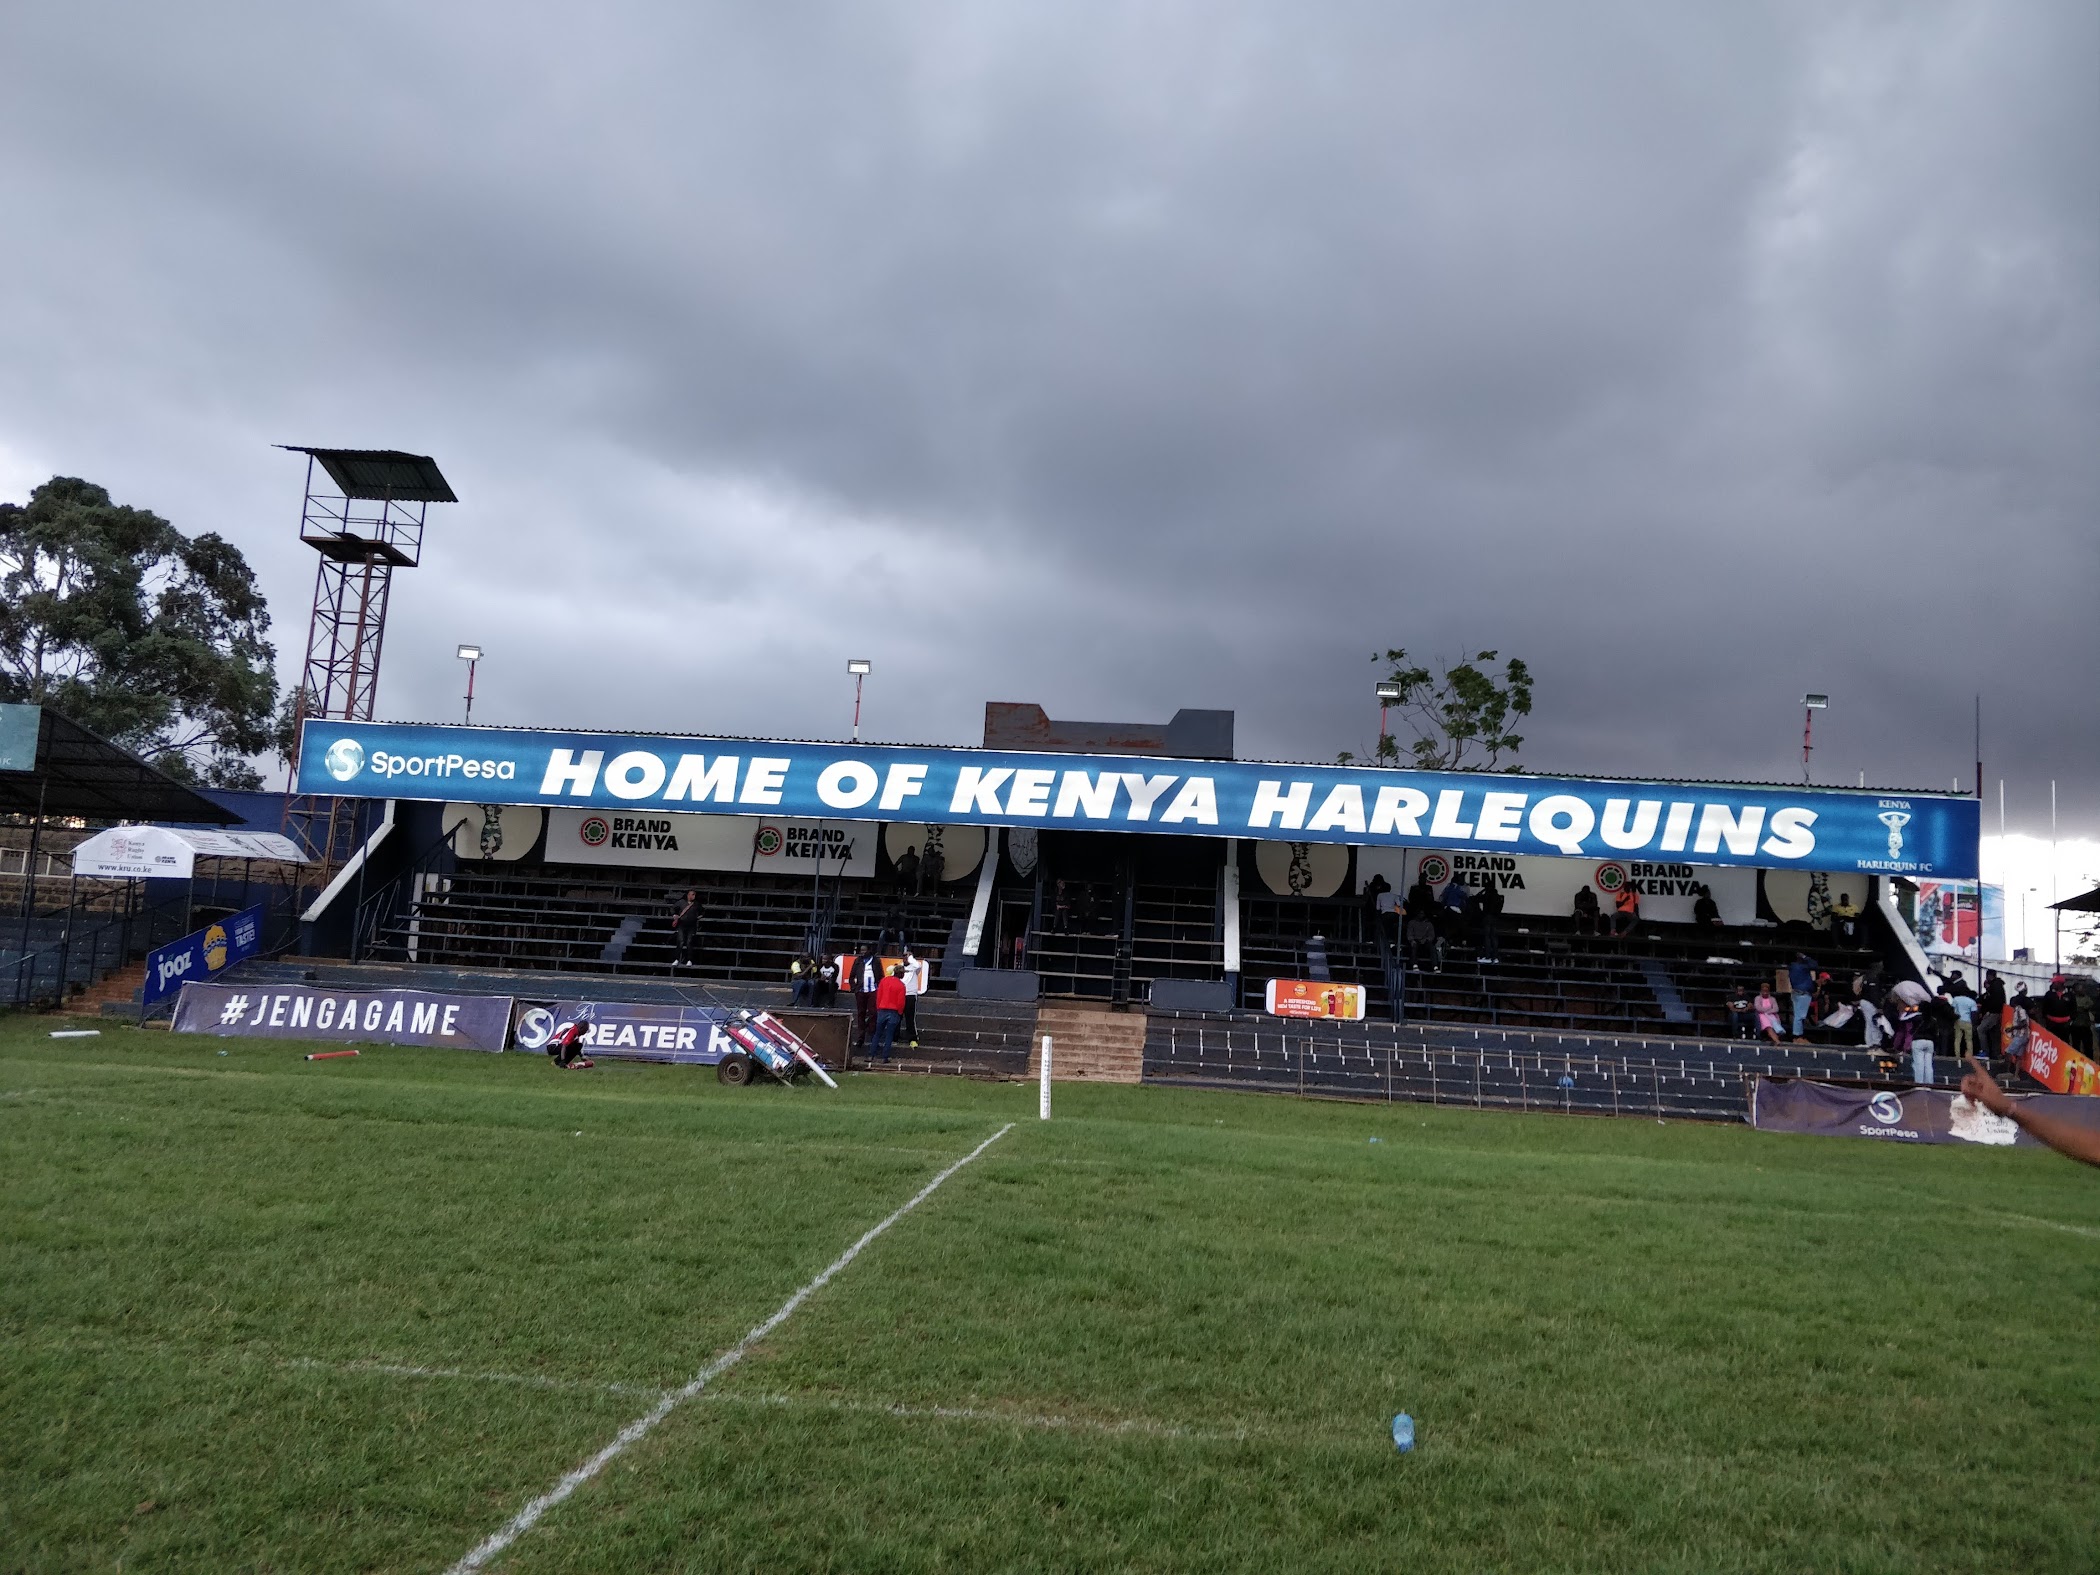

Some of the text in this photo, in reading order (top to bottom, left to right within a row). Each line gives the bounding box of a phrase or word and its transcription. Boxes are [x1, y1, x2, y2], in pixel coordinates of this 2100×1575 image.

[371, 751, 516, 780] SportPesa
[539, 748, 1819, 860] HOME OF KENYA HARLEQUINS
[1878, 800, 1911, 810] KENYA
[613, 817, 671, 833] BRAND
[611, 832, 679, 851] KENYA
[787, 827, 845, 842] BRAND
[785, 842, 853, 860] KENYA
[98, 864, 152, 873] www.kru.co.ke
[1454, 855, 1516, 871] BRAND
[1631, 863, 1693, 879] BRAND
[1857, 859, 1933, 872] HARLEQUIN FC
[1629, 878, 1702, 897] KENYA
[158, 951, 192, 992] jooz
[220, 994, 461, 1036] #JENGAGAME
[567, 1002, 597, 1020] For
[2031, 1031, 2058, 1064] Taste
[1859, 1125, 1919, 1139] SportPesa
